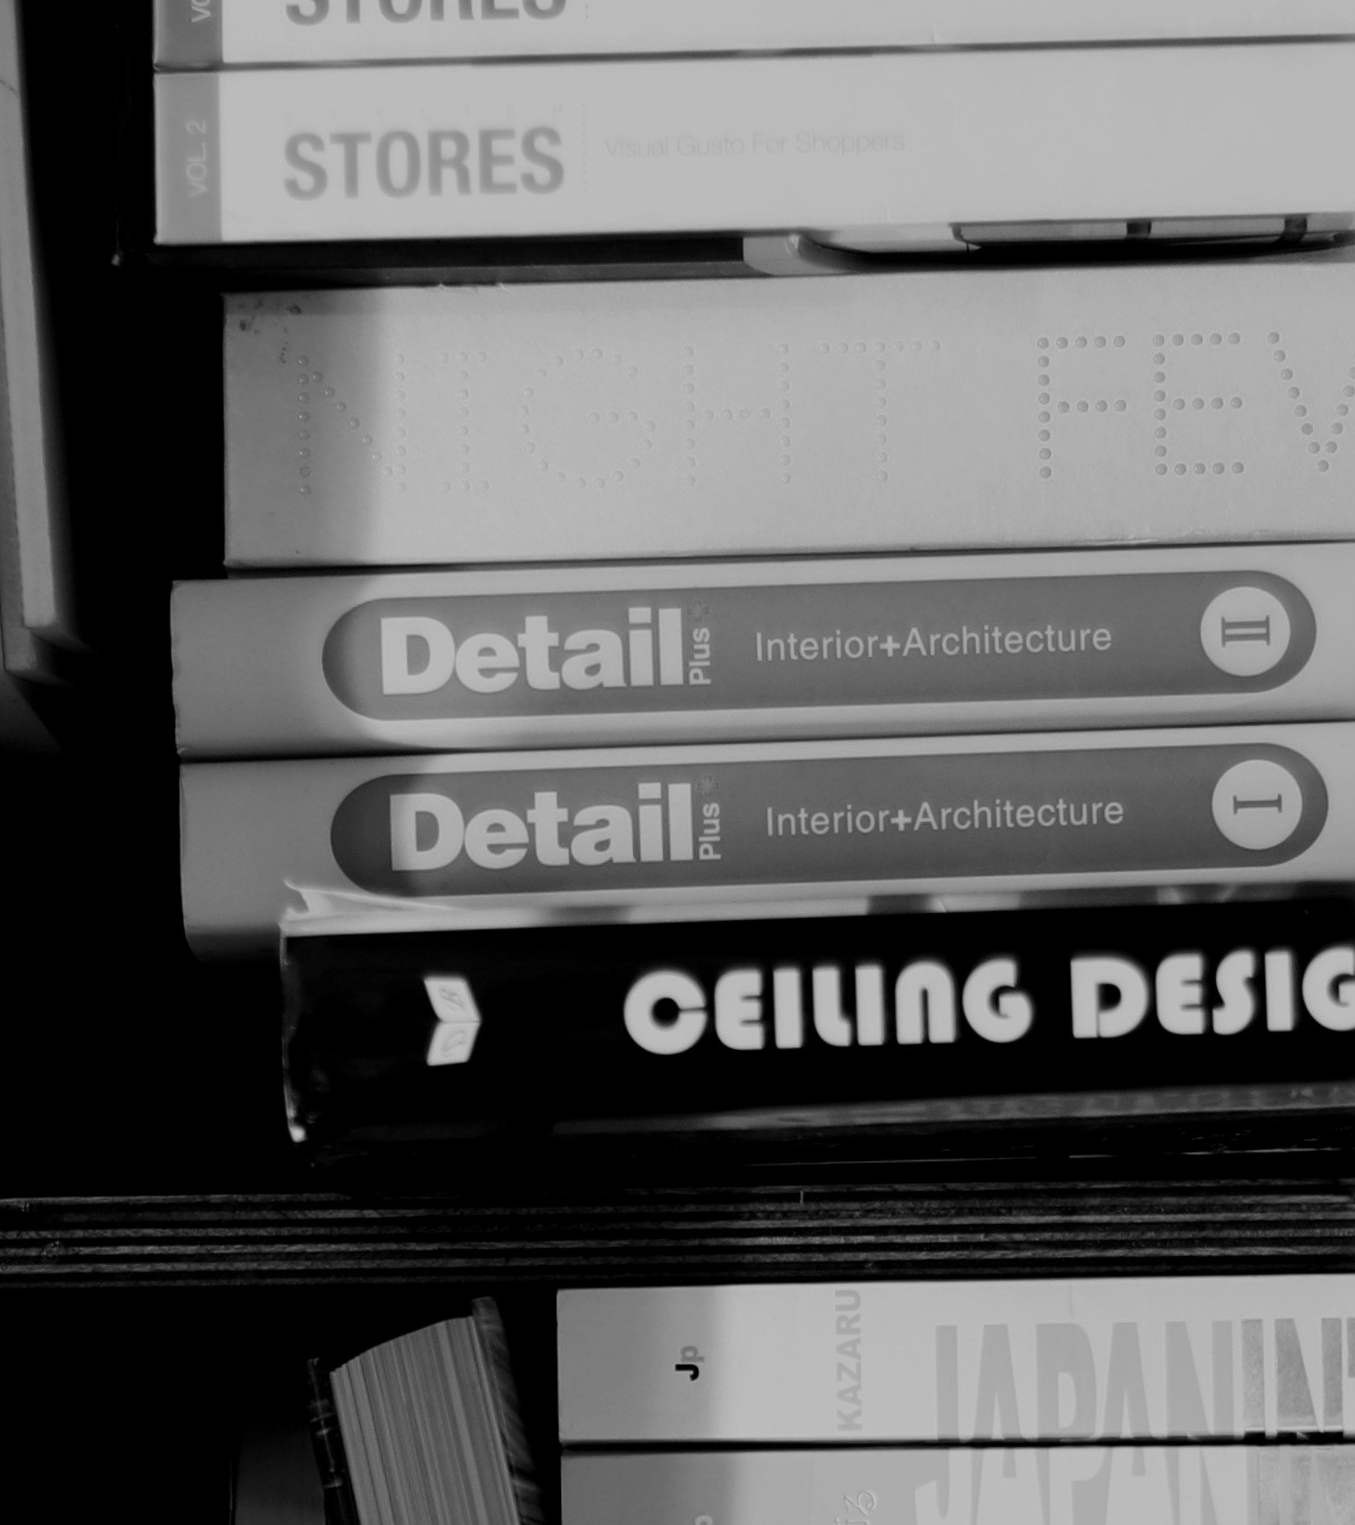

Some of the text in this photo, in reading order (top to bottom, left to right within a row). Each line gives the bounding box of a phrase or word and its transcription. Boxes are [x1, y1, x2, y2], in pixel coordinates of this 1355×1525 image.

[282, 126, 566, 202] STORES
[381, 606, 1113, 695] Detail Plus Interior+Architecture
[390, 782, 1125, 871] Detail Plus Interior+Architecture
[623, 958, 1034, 1056] CEILING
[833, 1289, 863, 1431] KAZARU
